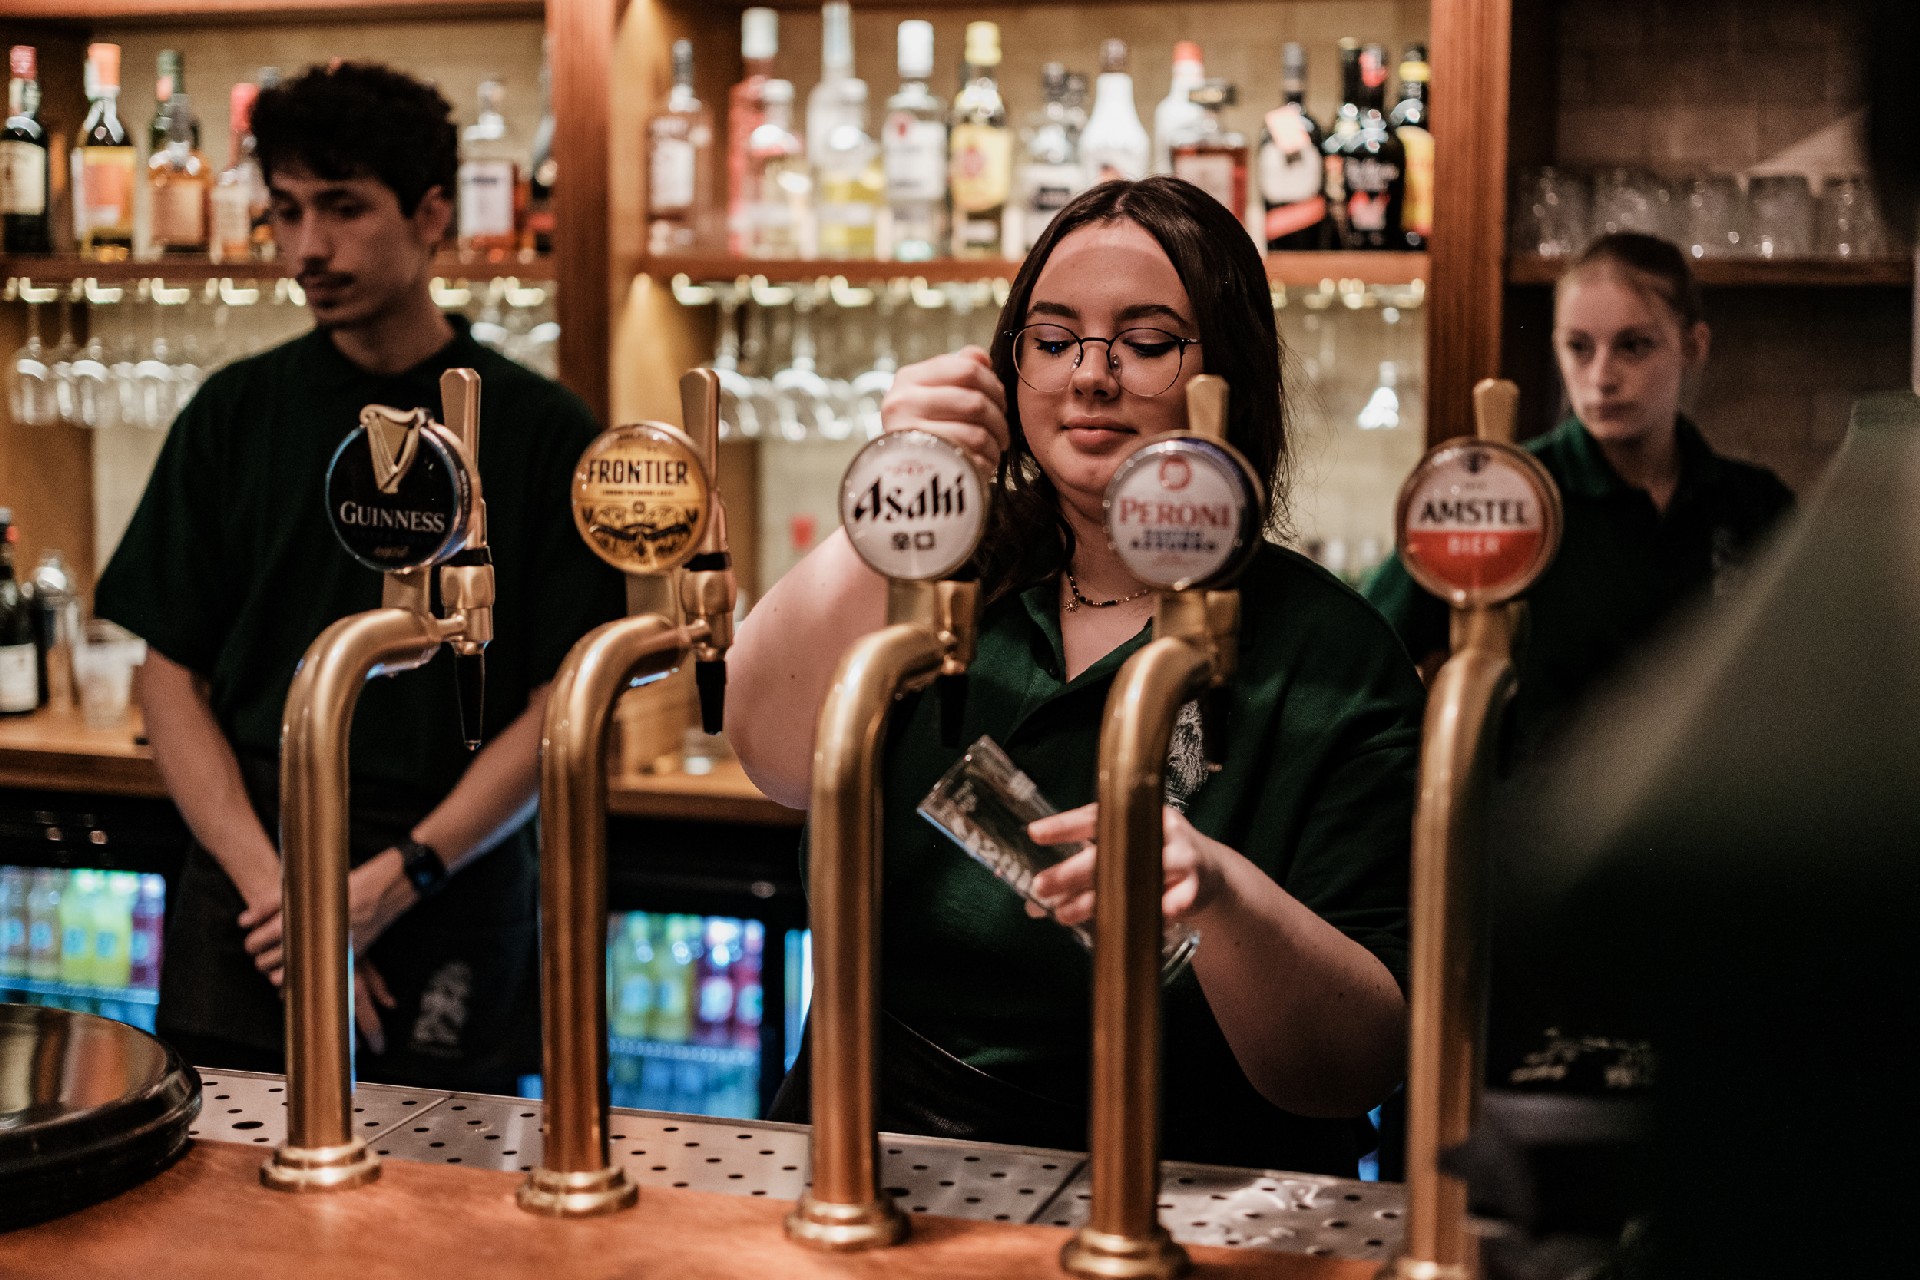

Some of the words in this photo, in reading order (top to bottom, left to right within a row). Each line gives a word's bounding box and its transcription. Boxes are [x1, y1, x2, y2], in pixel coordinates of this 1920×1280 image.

[588, 459, 689, 484] FRONTIER
[854, 473, 966, 521] Asahi
[1118, 497, 1231, 529] PERONI
[1420, 500, 1529, 524] AMSTEL
[339, 500, 445, 533] GUINNESS
